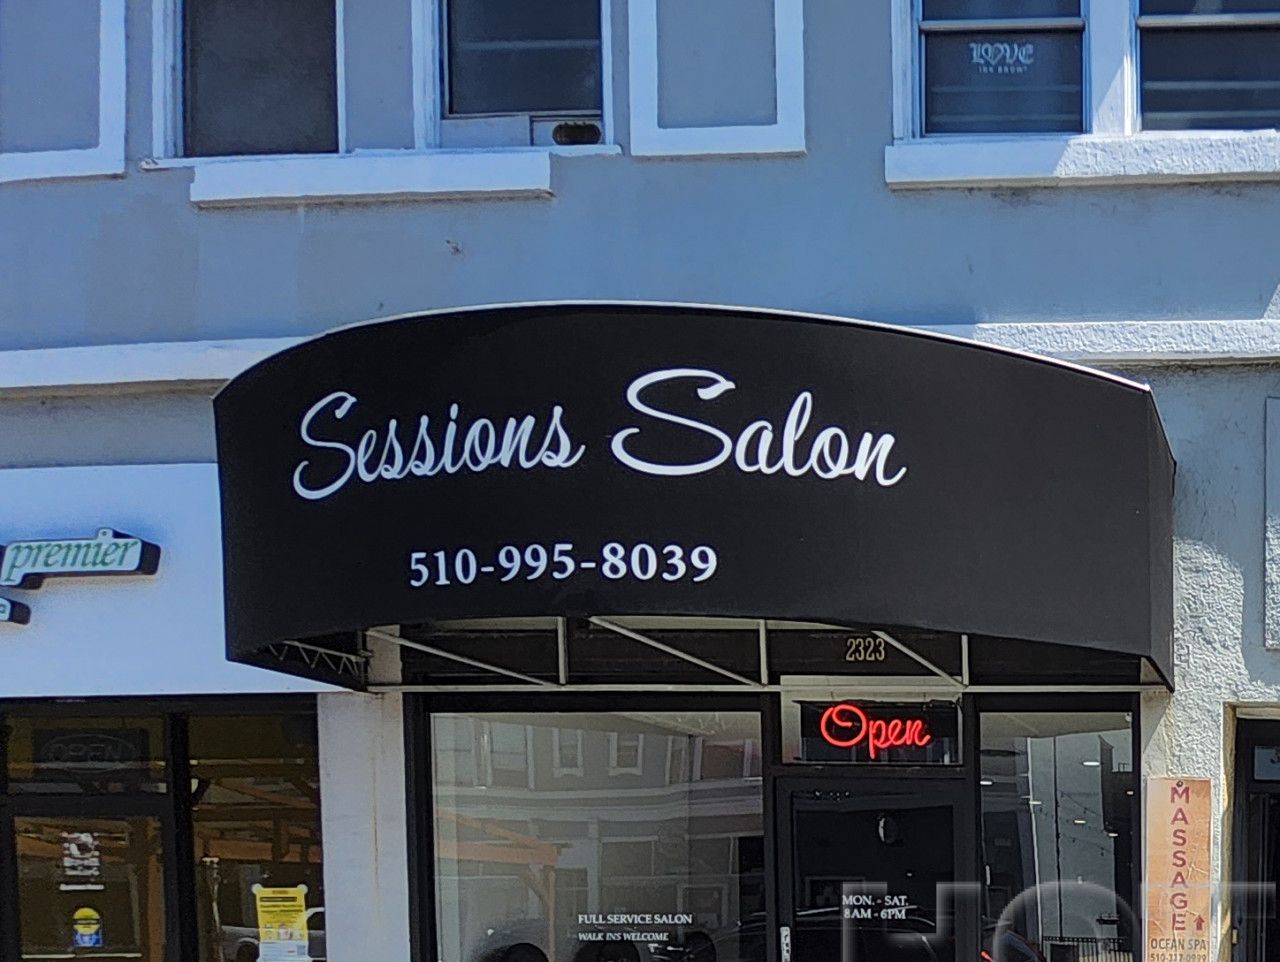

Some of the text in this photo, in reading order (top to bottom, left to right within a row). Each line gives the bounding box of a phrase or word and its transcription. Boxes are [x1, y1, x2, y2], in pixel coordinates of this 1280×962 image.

[291, 367, 908, 500] Sessions Salon
[4, 530, 139, 582] premier
[408, 542, 718, 588] 510-995-8039
[845, 637, 885, 662] 2323
[820, 703, 932, 760] Open
[1170, 786, 1190, 931] MASSAGE
[842, 895, 875, 906] MON.
[884, 895, 909, 906] SAT.
[577, 914, 692, 924] FULL SERVICE SALON
[843, 908, 872, 919] 8AM
[880, 908, 906, 919] 6PM
[578, 932, 604, 941] WALK
[622, 932, 670, 941] WELCOME
[1150, 938, 1207, 950] OCEAN SPA
